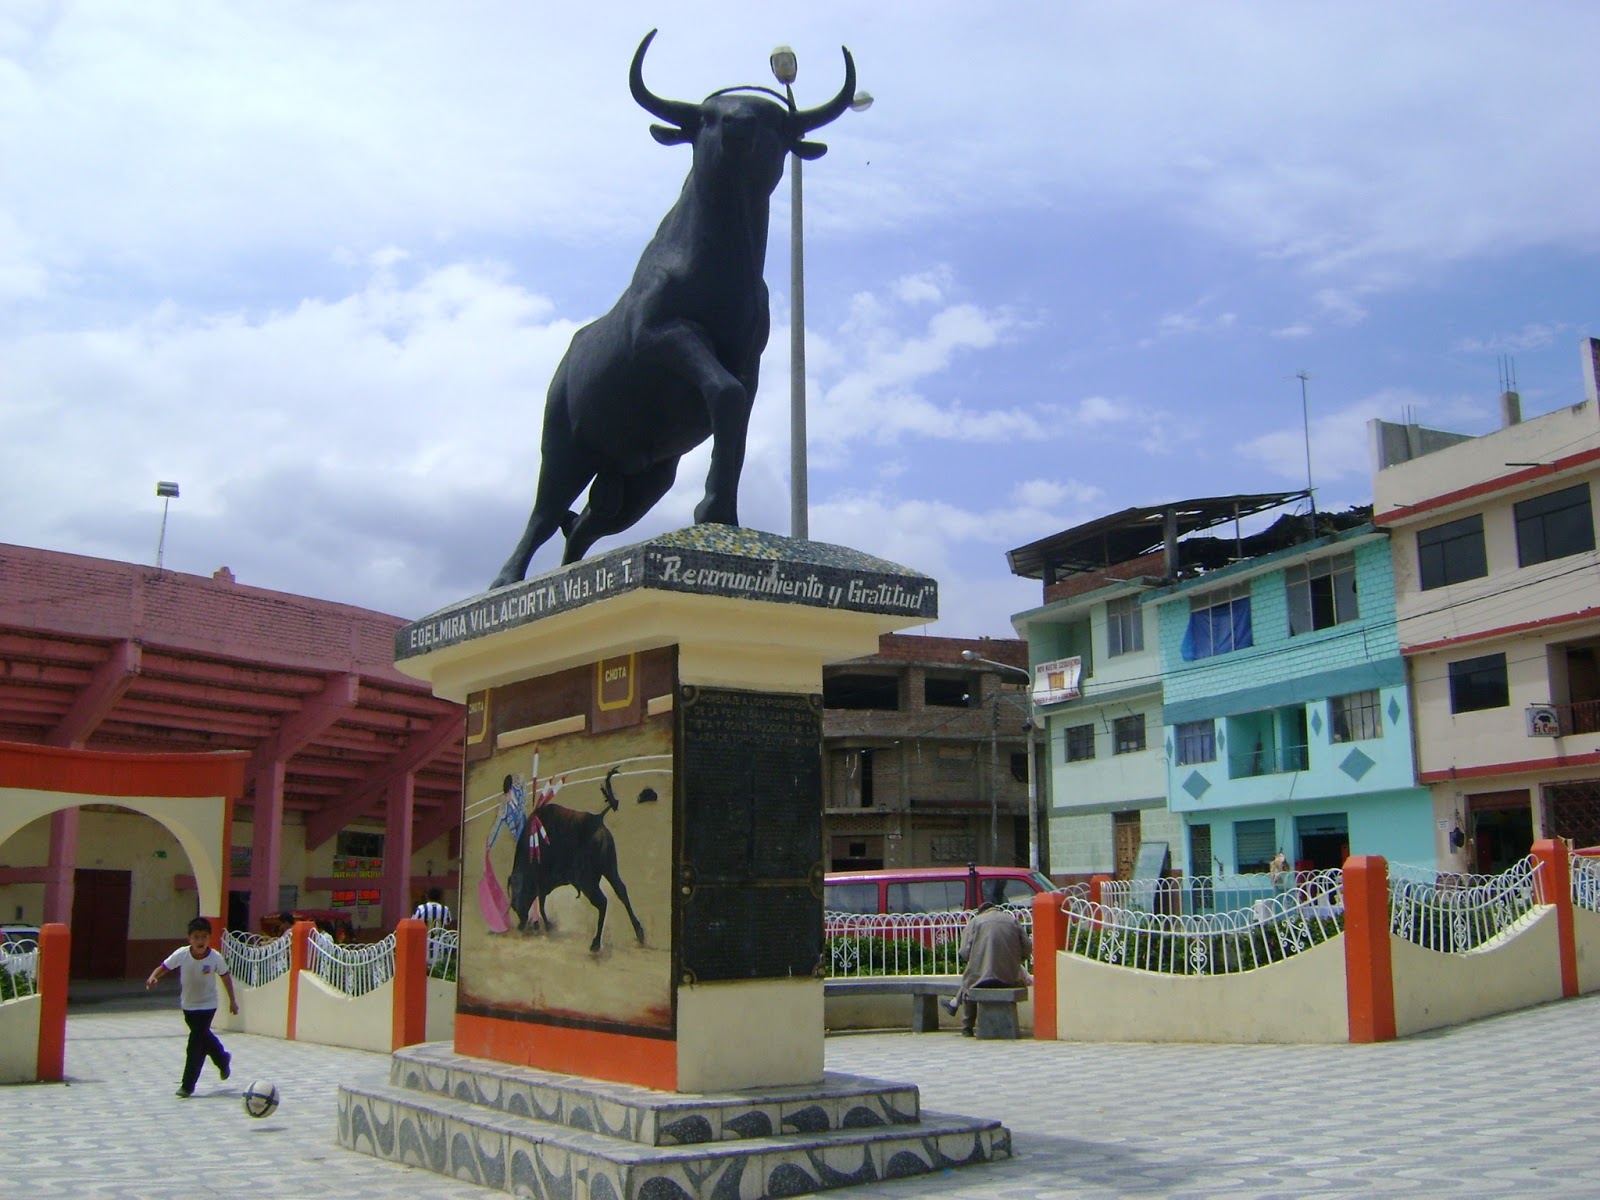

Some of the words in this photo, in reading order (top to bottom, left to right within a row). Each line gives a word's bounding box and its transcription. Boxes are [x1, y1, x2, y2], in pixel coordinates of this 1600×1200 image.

[828, 586, 842, 606] y
[410, 614, 467, 649] EDELMIRA
[470, 588, 556, 631] VILLACORTA
[605, 666, 627, 683] CHOTA
